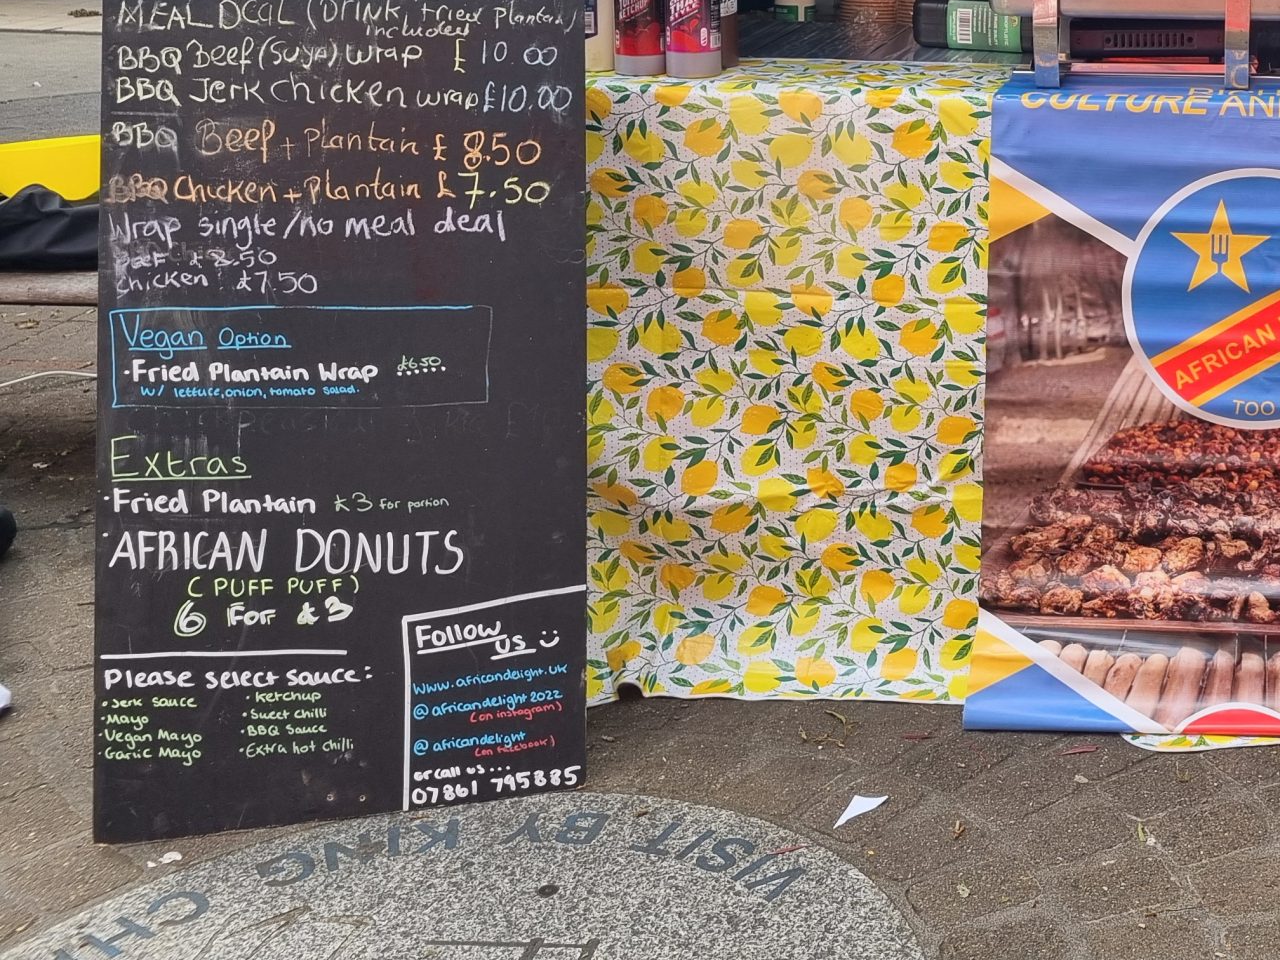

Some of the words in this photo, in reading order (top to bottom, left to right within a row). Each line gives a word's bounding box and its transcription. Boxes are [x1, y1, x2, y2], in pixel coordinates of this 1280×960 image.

[670, 3, 699, 21] STYLE
[118, 45, 182, 75] BBQ
[116, 76, 182, 107] BBQ
[1020, 91, 1210, 116] CULTURE
[280, 136, 296, 160] +
[109, 212, 181, 248] Wrap
[199, 211, 277, 250] single
[345, 206, 416, 240] meal
[434, 206, 506, 242] deal
[119, 313, 204, 359] Vegan
[218, 327, 288, 350] Option
[1174, 323, 1277, 391] AFRICAN
[132, 359, 200, 384] Fried
[208, 361, 309, 382] Plantain
[318, 362, 379, 383] Wrap
[1232, 399, 1275, 416] TOO
[110, 435, 249, 477] Extras
[113, 488, 189, 514] Fried
[202, 489, 316, 514] Plantain
[109, 528, 268, 572] AFRICAN
[295, 528, 464, 575] DONUTS
[174, 599, 206, 636] 6
[415, 621, 502, 648] Follow
[104, 669, 195, 690] Please
[205, 671, 279, 689] select
[107, 714, 149, 730] Mayo
[157, 729, 202, 748] Mayo
[292, 741, 316, 754] hot
[158, 747, 202, 766] Mayo
[412, 780, 477, 804] 07861
[501, 812, 609, 844] BY
[256, 818, 460, 887] KING
[628, 820, 806, 903] VISIT
[52, 890, 210, 960] CH
